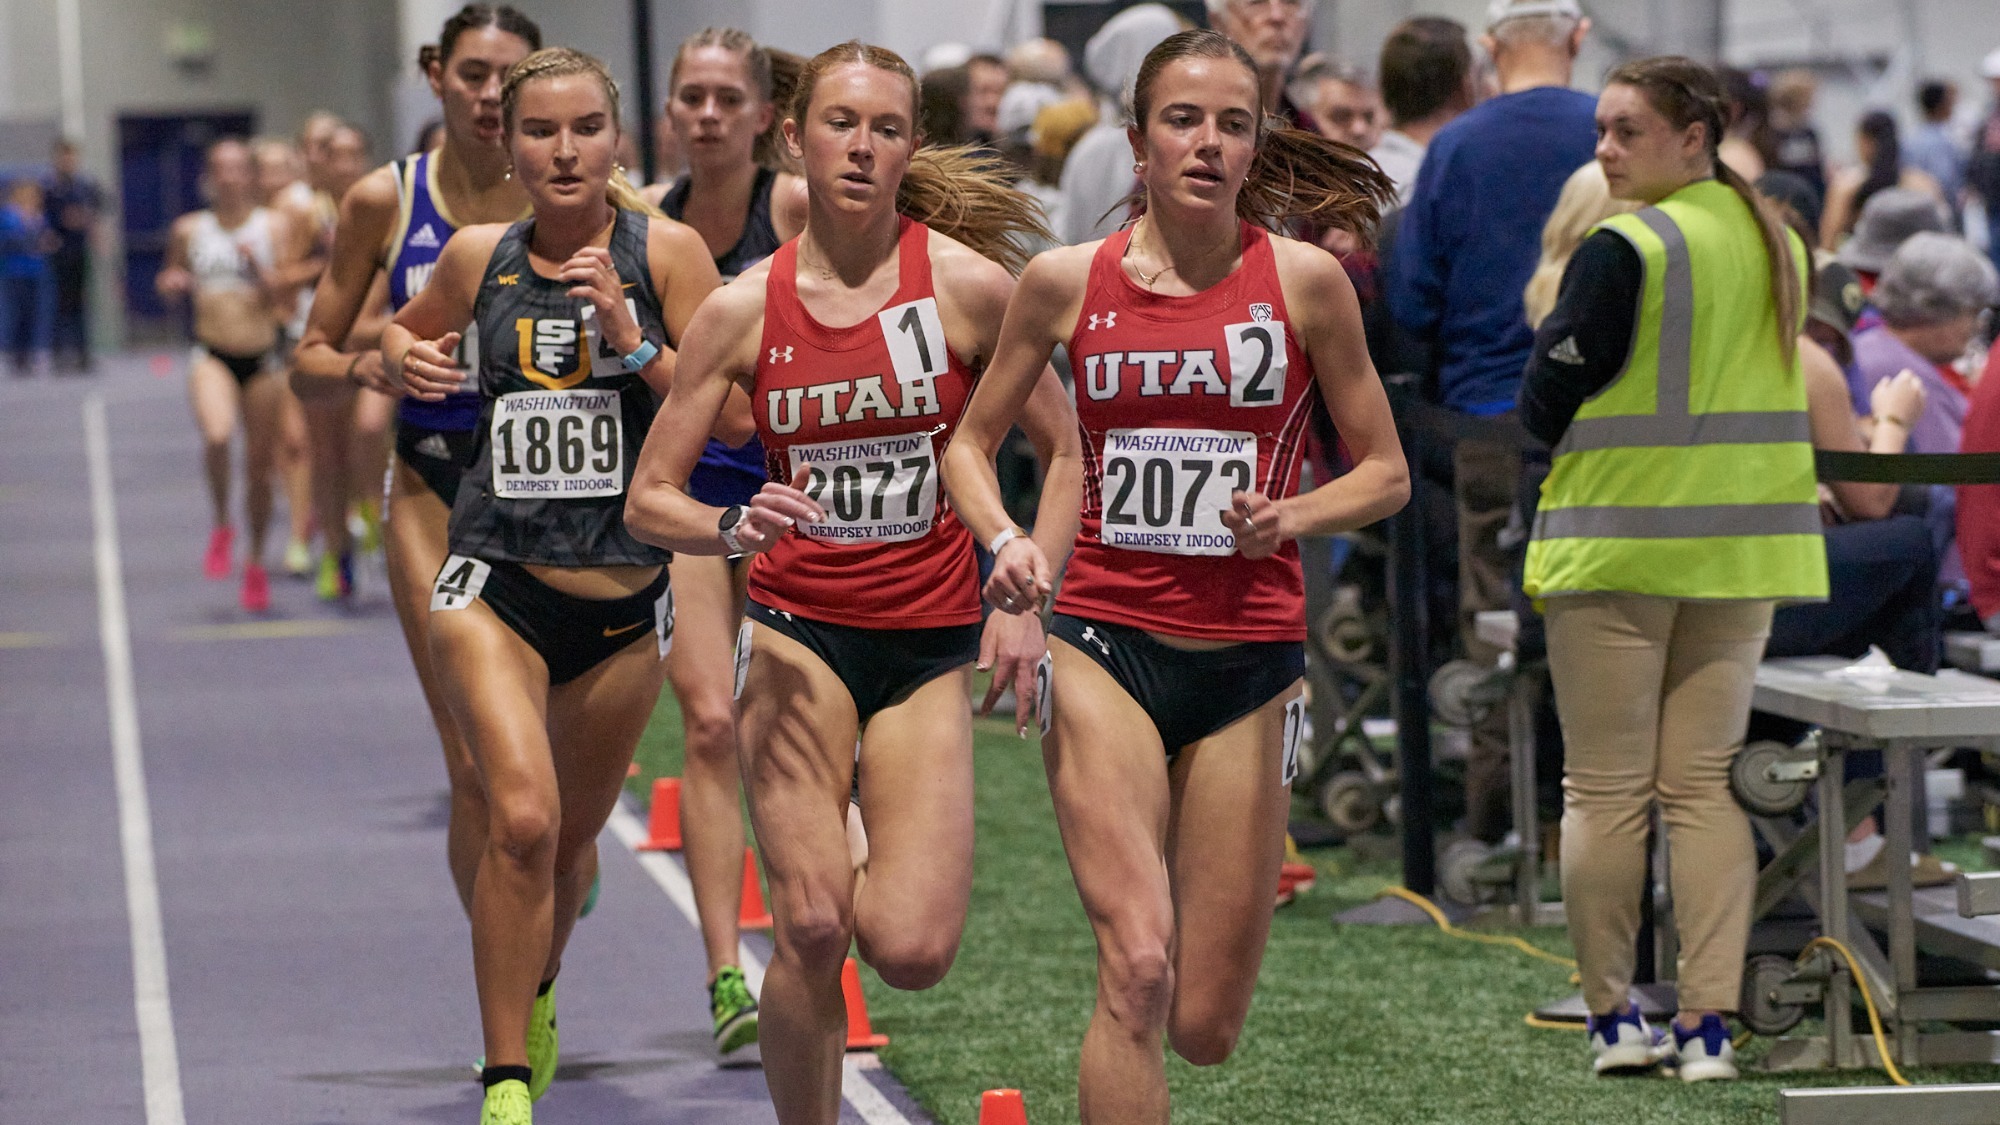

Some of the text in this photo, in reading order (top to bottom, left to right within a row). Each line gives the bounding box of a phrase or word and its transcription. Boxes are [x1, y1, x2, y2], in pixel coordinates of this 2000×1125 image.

[1251, 304, 1271, 318] PAC
[898, 306, 933, 373] 1
[1084, 350, 1229, 401] UTA
[1240, 327, 1274, 402] 2
[505, 395, 611, 413] WASHINGTON
[767, 374, 942, 435] UTAH
[497, 415, 619, 475] 1869
[799, 436, 921, 462] WASHINGTON
[1114, 435, 1246, 454] WASHINGTON
[506, 479, 613, 492] DEMPSEY INDOOR
[803, 455, 931, 522] 2077
[1105, 457, 1250, 528] 2073
[809, 519, 929, 538] DEMPSEY INDOOR
[1114, 532, 1234, 548] DEMPSEY INDOO
[437, 560, 475, 606] 4
[1286, 703, 1300, 780] 2
